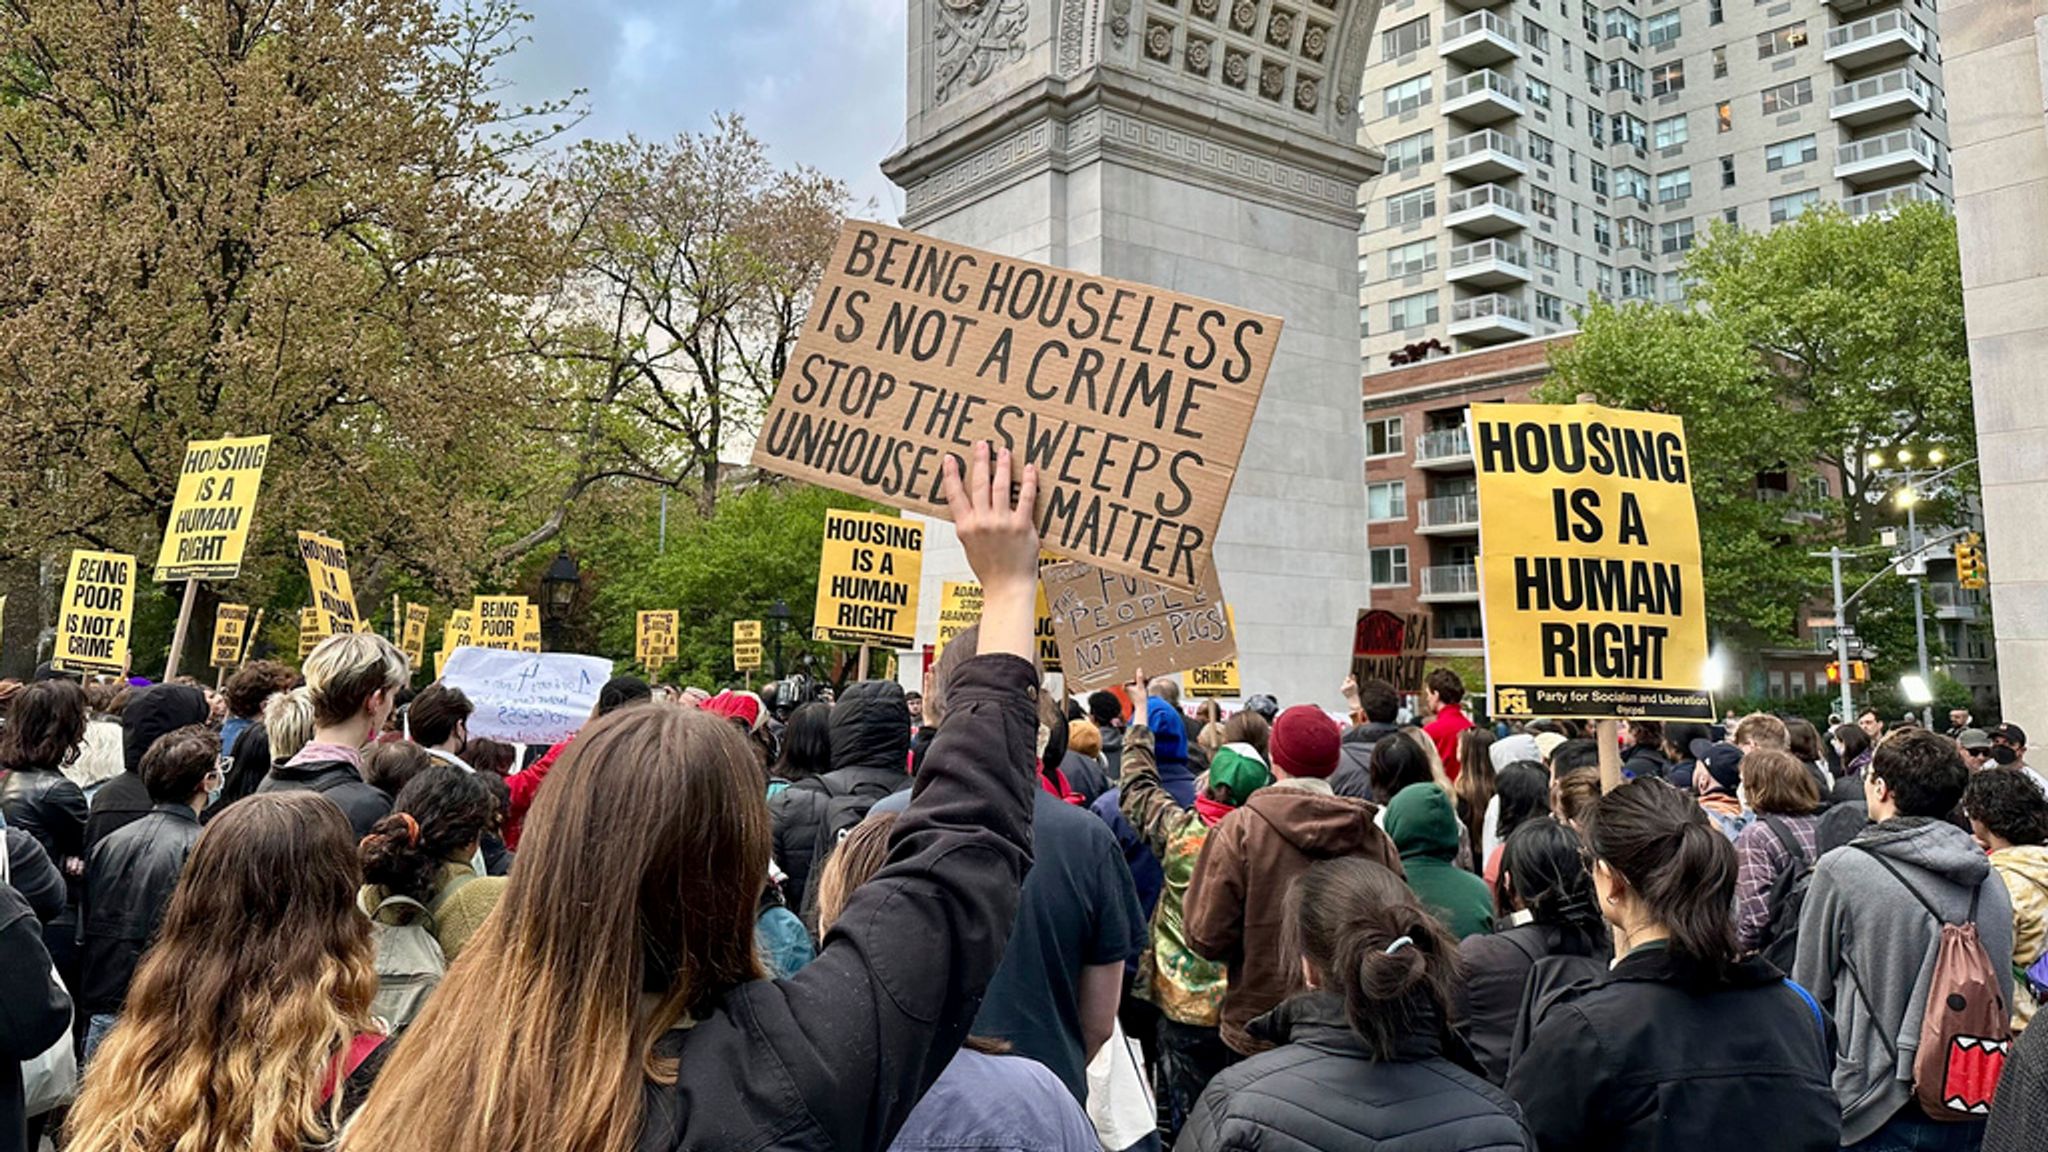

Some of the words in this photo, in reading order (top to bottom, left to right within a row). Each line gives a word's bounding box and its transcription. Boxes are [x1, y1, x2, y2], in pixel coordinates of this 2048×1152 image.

[844, 229, 977, 304] BEING
[978, 262, 1264, 384] HOUSELESS
[817, 286, 870, 343] IS
[876, 302, 978, 367] NOT
[976, 327, 1014, 384] A
[1026, 340, 1217, 439] CRIME
[792, 353, 896, 419] STOP
[902, 381, 987, 447] THE
[994, 405, 1204, 517] SWEEPS
[184, 443, 265, 474] HOUSING
[1478, 421, 1686, 484] HOUSING
[195, 477, 215, 501] IS
[218, 477, 234, 501] A
[766, 408, 967, 504] UNHOUSED
[1040, 486, 1204, 585] MATTER
[175, 507, 242, 534] HUMAN
[1552, 488, 1604, 543] IS
[1619, 491, 1649, 546] A
[827, 517, 922, 551] HOUSING
[176, 536, 227, 562] RIGHT
[852, 549, 874, 572] IS
[879, 553, 894, 576] A
[77, 558, 127, 585] BEING
[73, 585, 123, 611] POOR
[831, 576, 908, 605] HUMAN
[1514, 556, 1682, 616] HUMAN
[480, 601, 519, 617] BEING
[838, 603, 897, 631] RIGHT
[65, 613, 80, 633] IS
[81, 615, 112, 637] NOT
[116, 619, 125, 638] A
[481, 620, 515, 637] POOR
[68, 637, 115, 659] CRIME
[1076, 635, 1117, 672] NOT
[1129, 625, 1163, 653] THE
[1169, 609, 1226, 647] PIGS
[1541, 622, 1668, 680] RIGHT
[1499, 692, 1532, 714] PSL
[1537, 690, 1568, 703] Party
[1570, 690, 1588, 702] for
[1592, 690, 1637, 703] Socialism
[1640, 692, 1657, 704] and
[1659, 694, 1709, 706] Liberation
